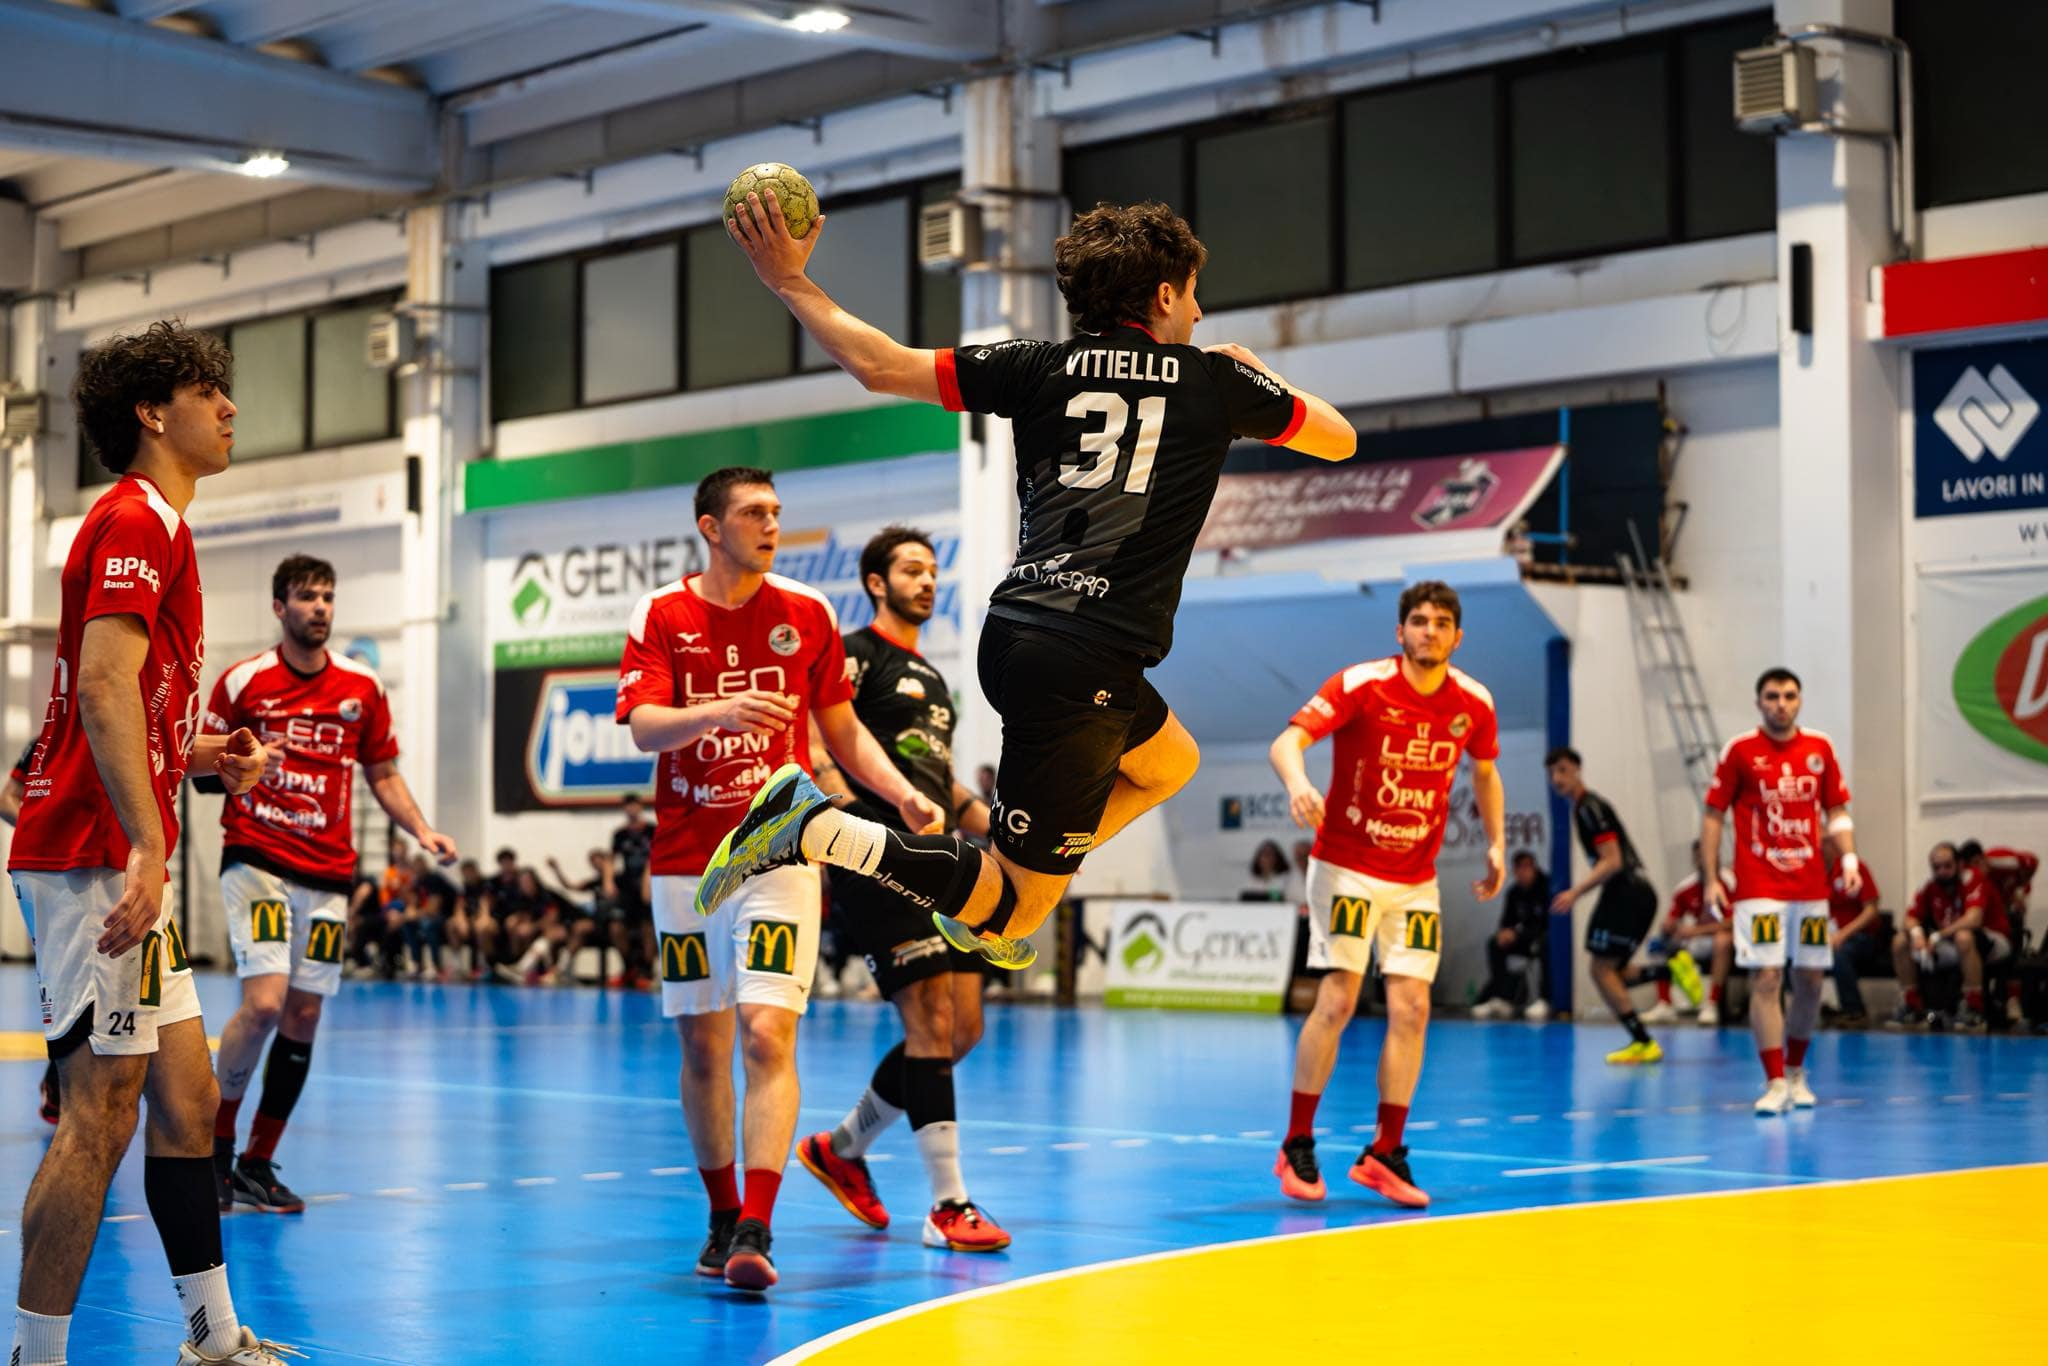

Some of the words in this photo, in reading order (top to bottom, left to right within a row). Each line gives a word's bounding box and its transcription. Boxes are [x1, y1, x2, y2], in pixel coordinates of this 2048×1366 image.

[1065, 349, 1179, 384] VITIELLO
[1057, 391, 1167, 494] 31
[1942, 474, 2017, 503] LAVORI
[2021, 472, 2045, 496] IN
[103, 580, 134, 589] Banca
[726, 644, 740, 667] 6
[929, 704, 950, 730] 32
[108, 1011, 136, 1036] 24
